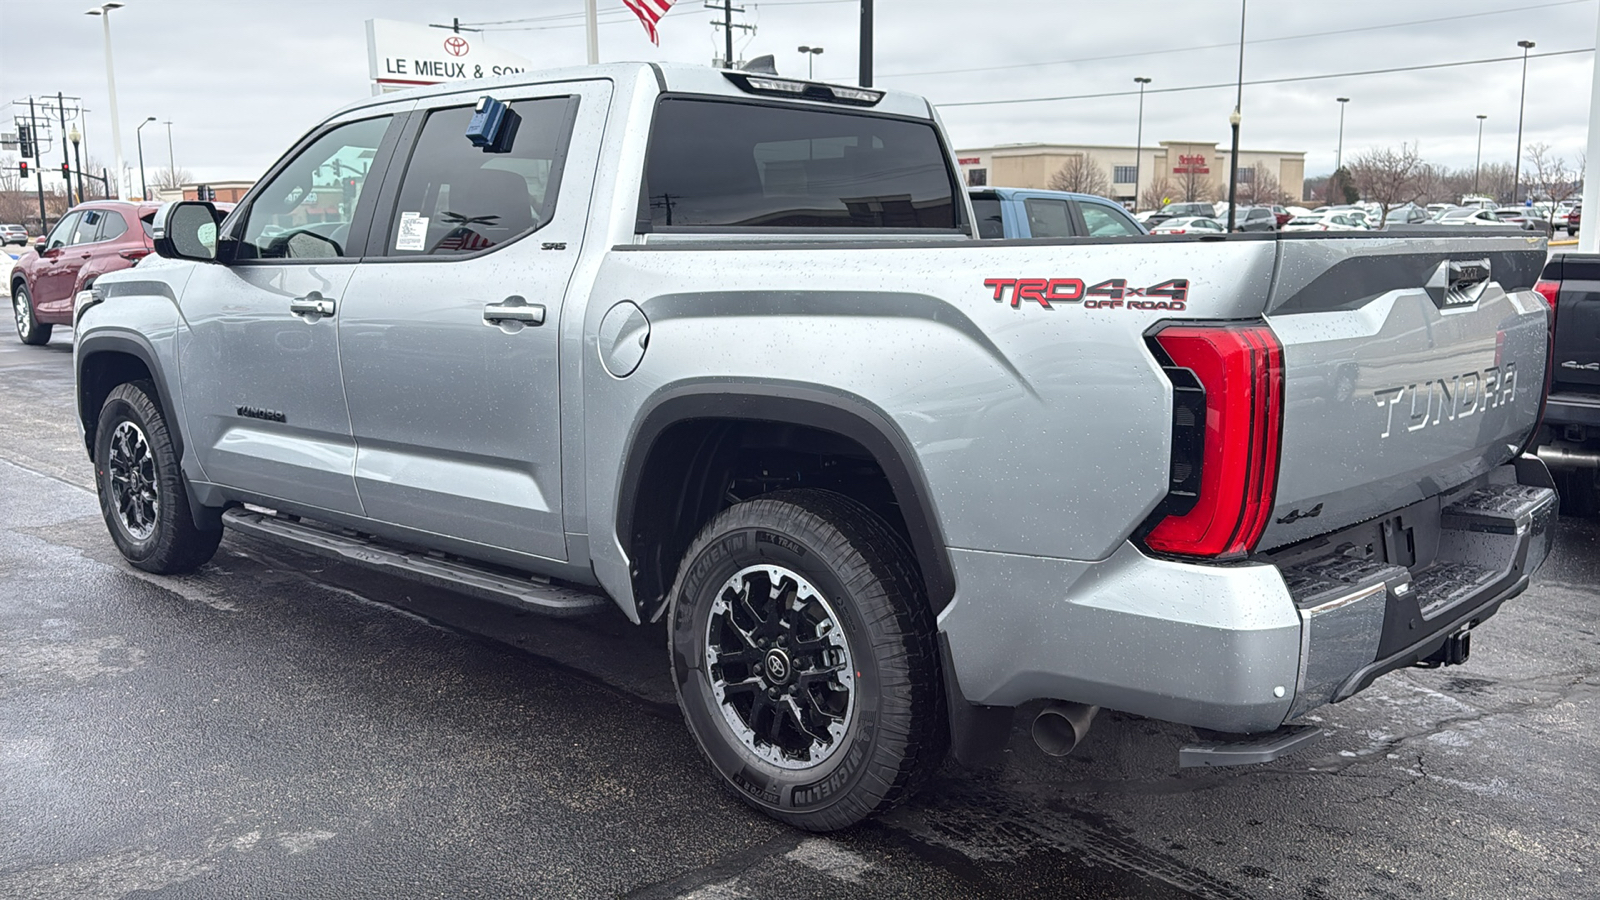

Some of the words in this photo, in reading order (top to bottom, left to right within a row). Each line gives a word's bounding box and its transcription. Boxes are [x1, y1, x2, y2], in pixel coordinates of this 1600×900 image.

[386, 57, 408, 75] LE
[414, 60, 467, 79] MIEUX
[473, 64, 484, 79] &
[540, 241, 567, 251] SR5
[984, 278, 1087, 310] TRD
[1083, 300, 1125, 310] OFF
[1126, 300, 1187, 311] ROAD
[1373, 362, 1518, 439] TUNDRA
[235, 404, 287, 423] TUNDRA
[778, 536, 801, 553] TRAIL
[684, 535, 744, 602] MICHELIN
[794, 742, 863, 804] MICHELIN
